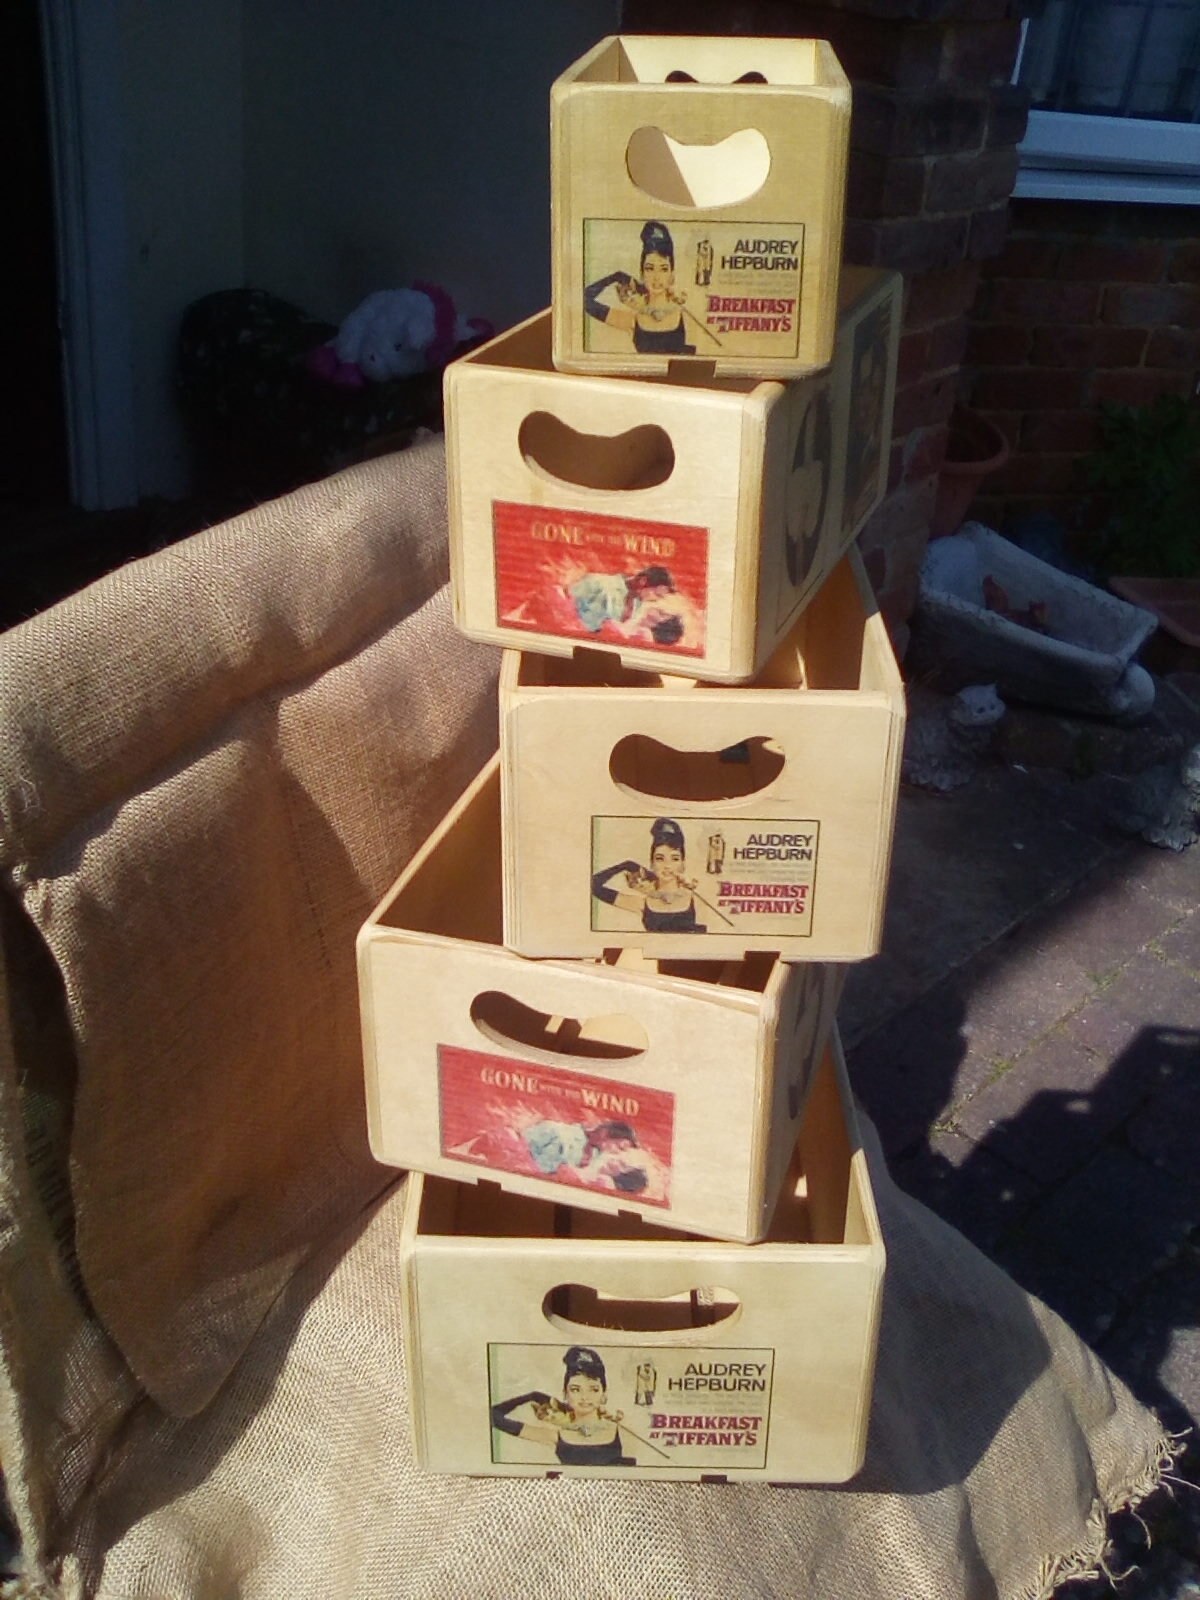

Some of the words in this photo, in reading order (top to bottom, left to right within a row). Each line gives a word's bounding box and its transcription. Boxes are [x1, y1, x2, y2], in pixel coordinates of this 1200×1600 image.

[734, 239, 799, 254] AUDREY
[721, 255, 799, 270] HEPBURN
[706, 295, 797, 314] BREAKFAST
[623, 533, 676, 557] WIND
[747, 833, 814, 847] AUDREY
[734, 847, 813, 861] HEPBURN
[717, 881, 809, 898] BREAKFAST
[480, 1067, 538, 1094] GONE
[580, 1088, 640, 1117] WIND
[684, 1362, 767, 1376] AUDREY
[668, 1378, 766, 1391] HEPBURN
[649, 1413, 763, 1430] BREAKFAST
[662, 1430, 757, 1447] TIFFANY'S
